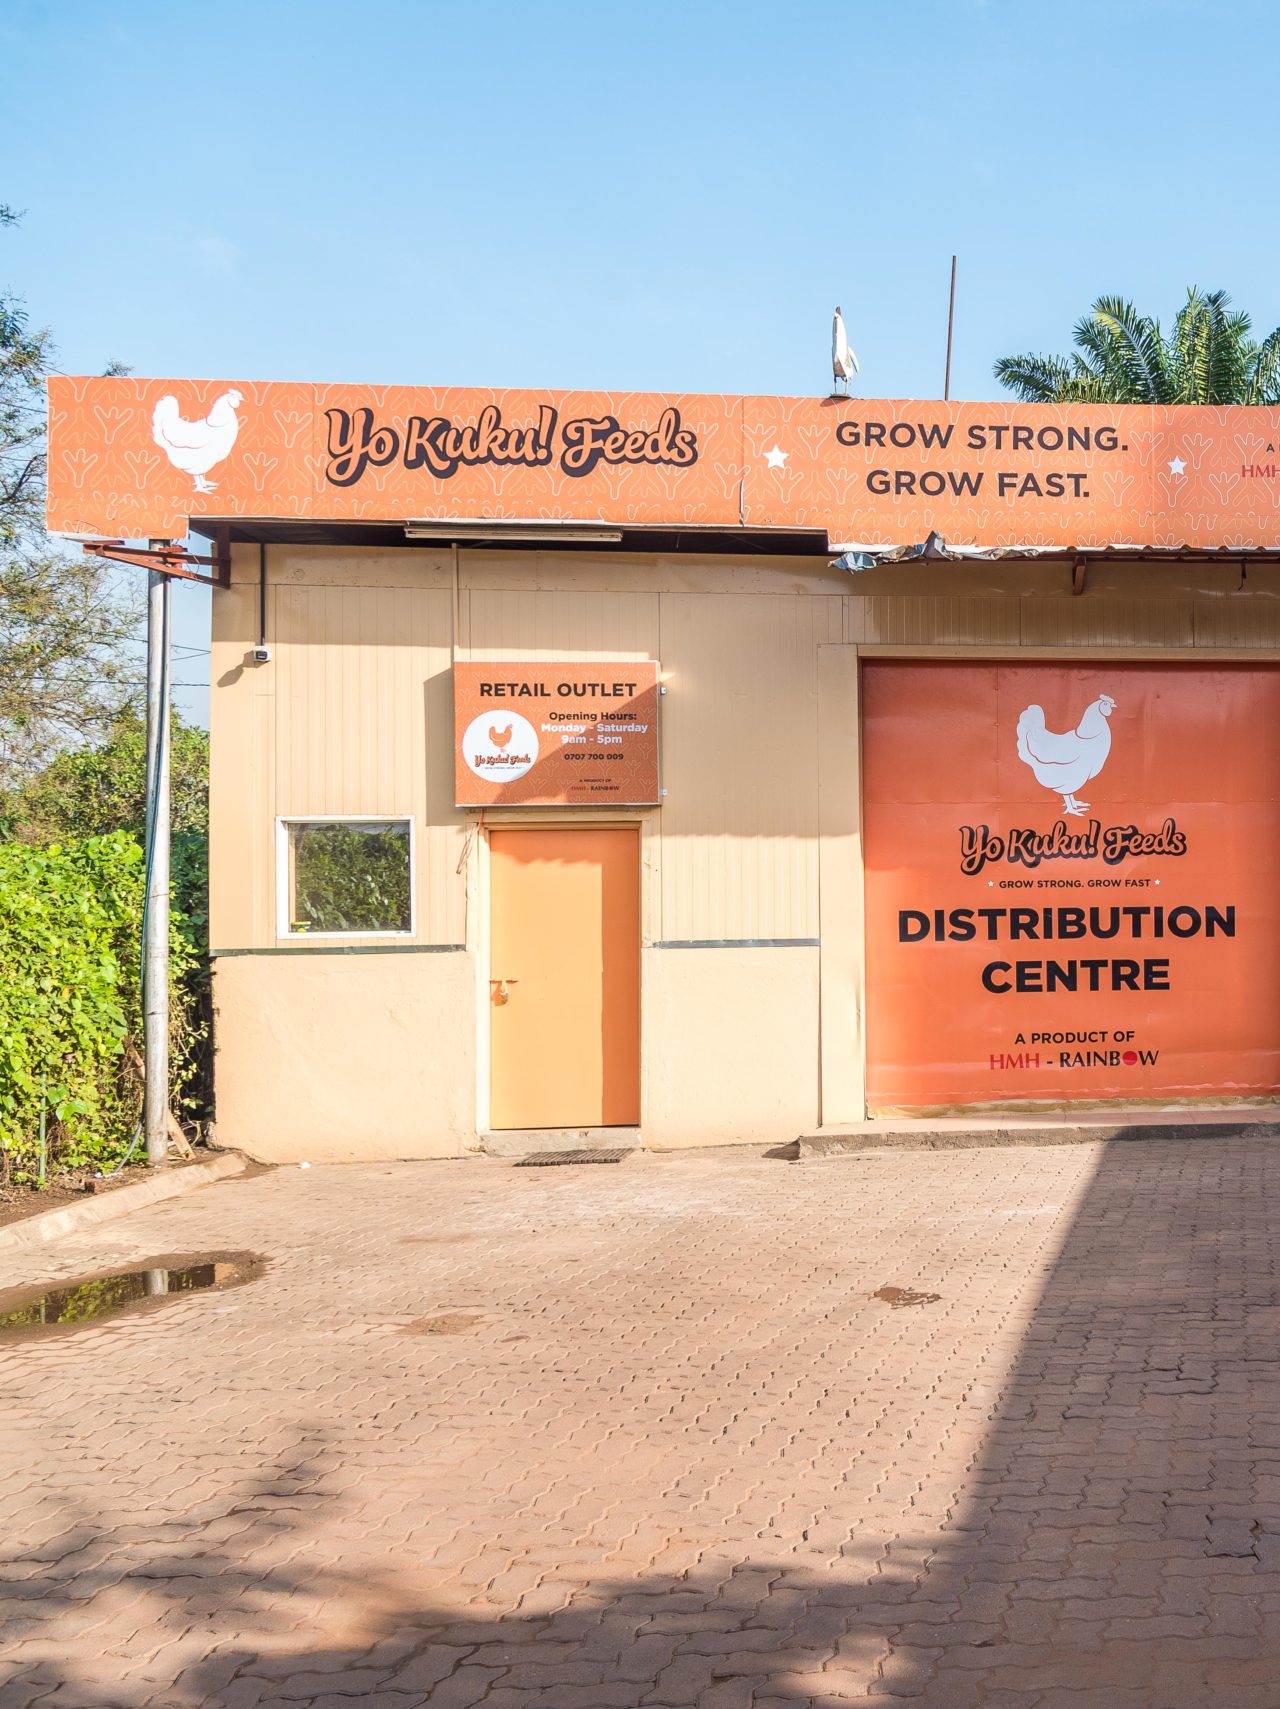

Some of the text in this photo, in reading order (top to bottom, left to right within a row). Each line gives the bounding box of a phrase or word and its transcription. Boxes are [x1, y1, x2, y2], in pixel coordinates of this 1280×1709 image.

[326, 405, 697, 487] Yo Kuku! Feeds
[836, 422, 1129, 452] GROW STRONG.
[1266, 444, 1275, 453] A
[866, 470, 1090, 499] GROW FAST.
[480, 682, 637, 697] RETAIL OUTLET
[549, 712, 637, 721] Opening Hours:
[541, 723, 586, 733] Monday
[597, 723, 648, 733] Saturday
[561, 735, 586, 743] 9am
[597, 735, 622, 745] 5pm
[959, 818, 1187, 875] Yo Kuku! Feeds
[999, 879, 1151, 889] GROW STRONG. GROW FAST
[899, 906, 1236, 943] DISTRIBUTION
[981, 959, 1171, 994] CENTRE
[1014, 1031, 1136, 1045] A PRODUCT OF
[990, 1053, 1040, 1070] HMH
[1060, 1049, 1160, 1068] RAINBOW
